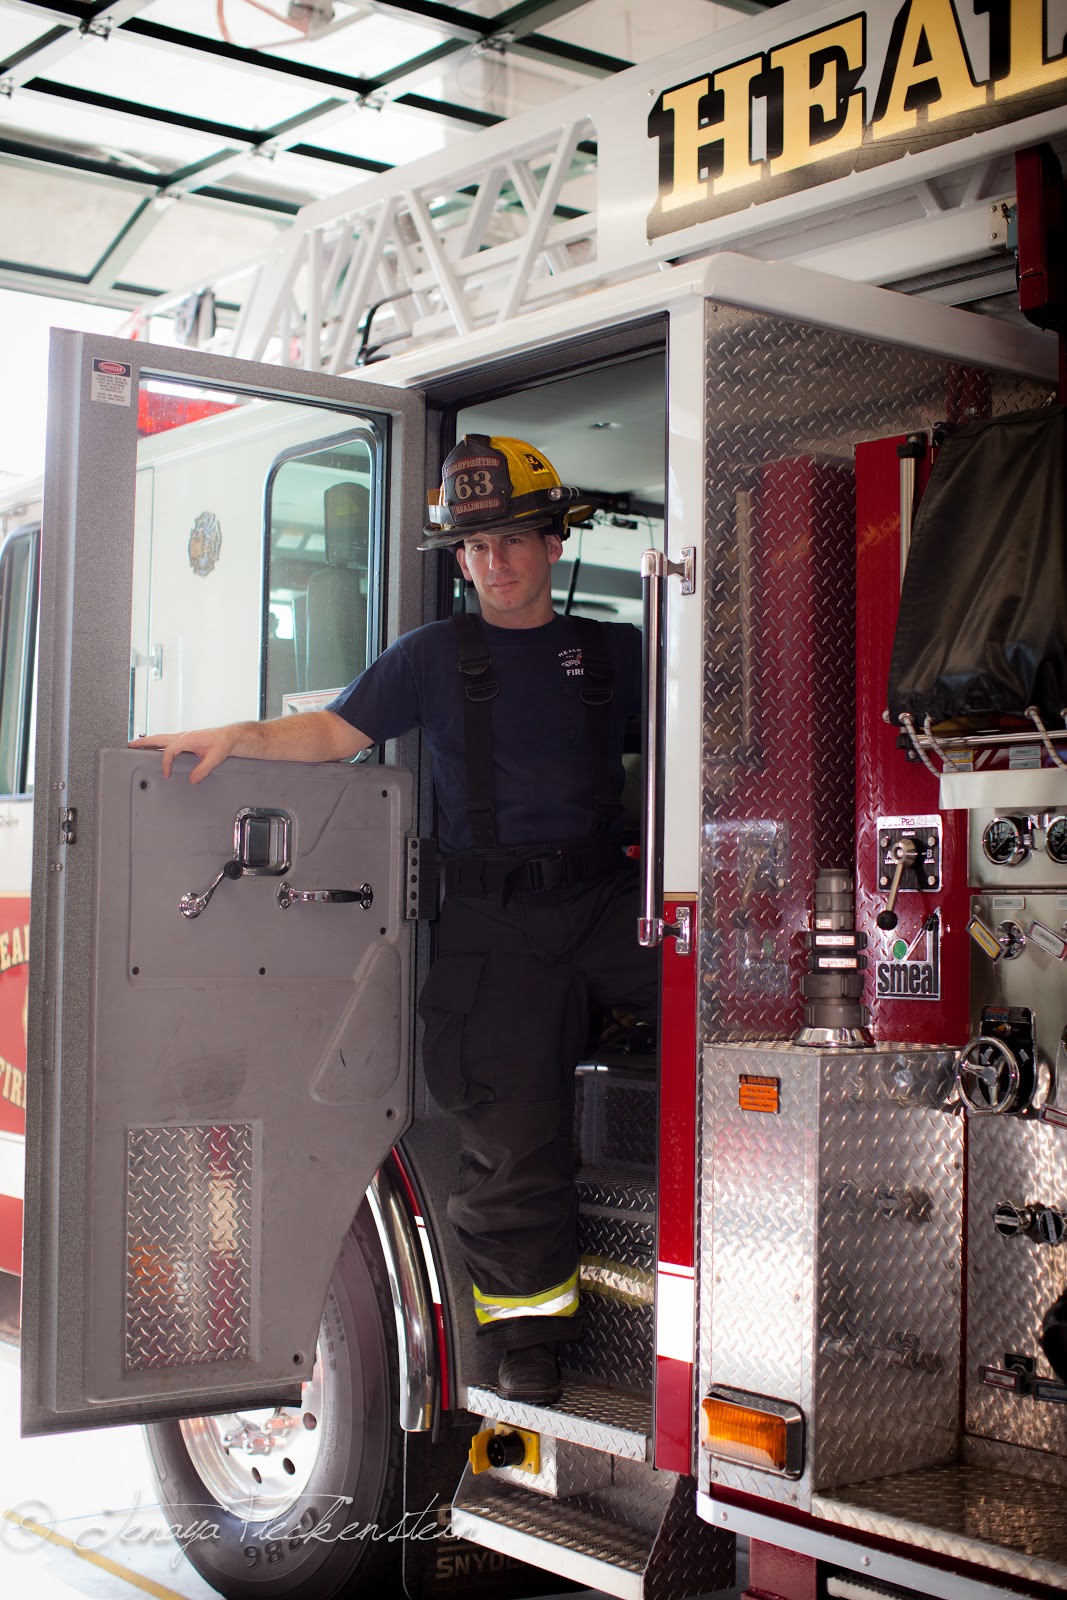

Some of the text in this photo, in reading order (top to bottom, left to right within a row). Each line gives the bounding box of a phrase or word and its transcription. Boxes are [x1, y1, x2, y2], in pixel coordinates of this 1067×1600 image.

[101, 364, 123, 372] DANGER
[447, 458, 498, 474] FIREFIGHTER
[455, 470, 494, 500] 63
[455, 499, 498, 514] HEALDSBURG
[926, 849, 933, 858] B
[877, 962, 939, 994] smeal
[435, 1551, 526, 1580] SNYD
